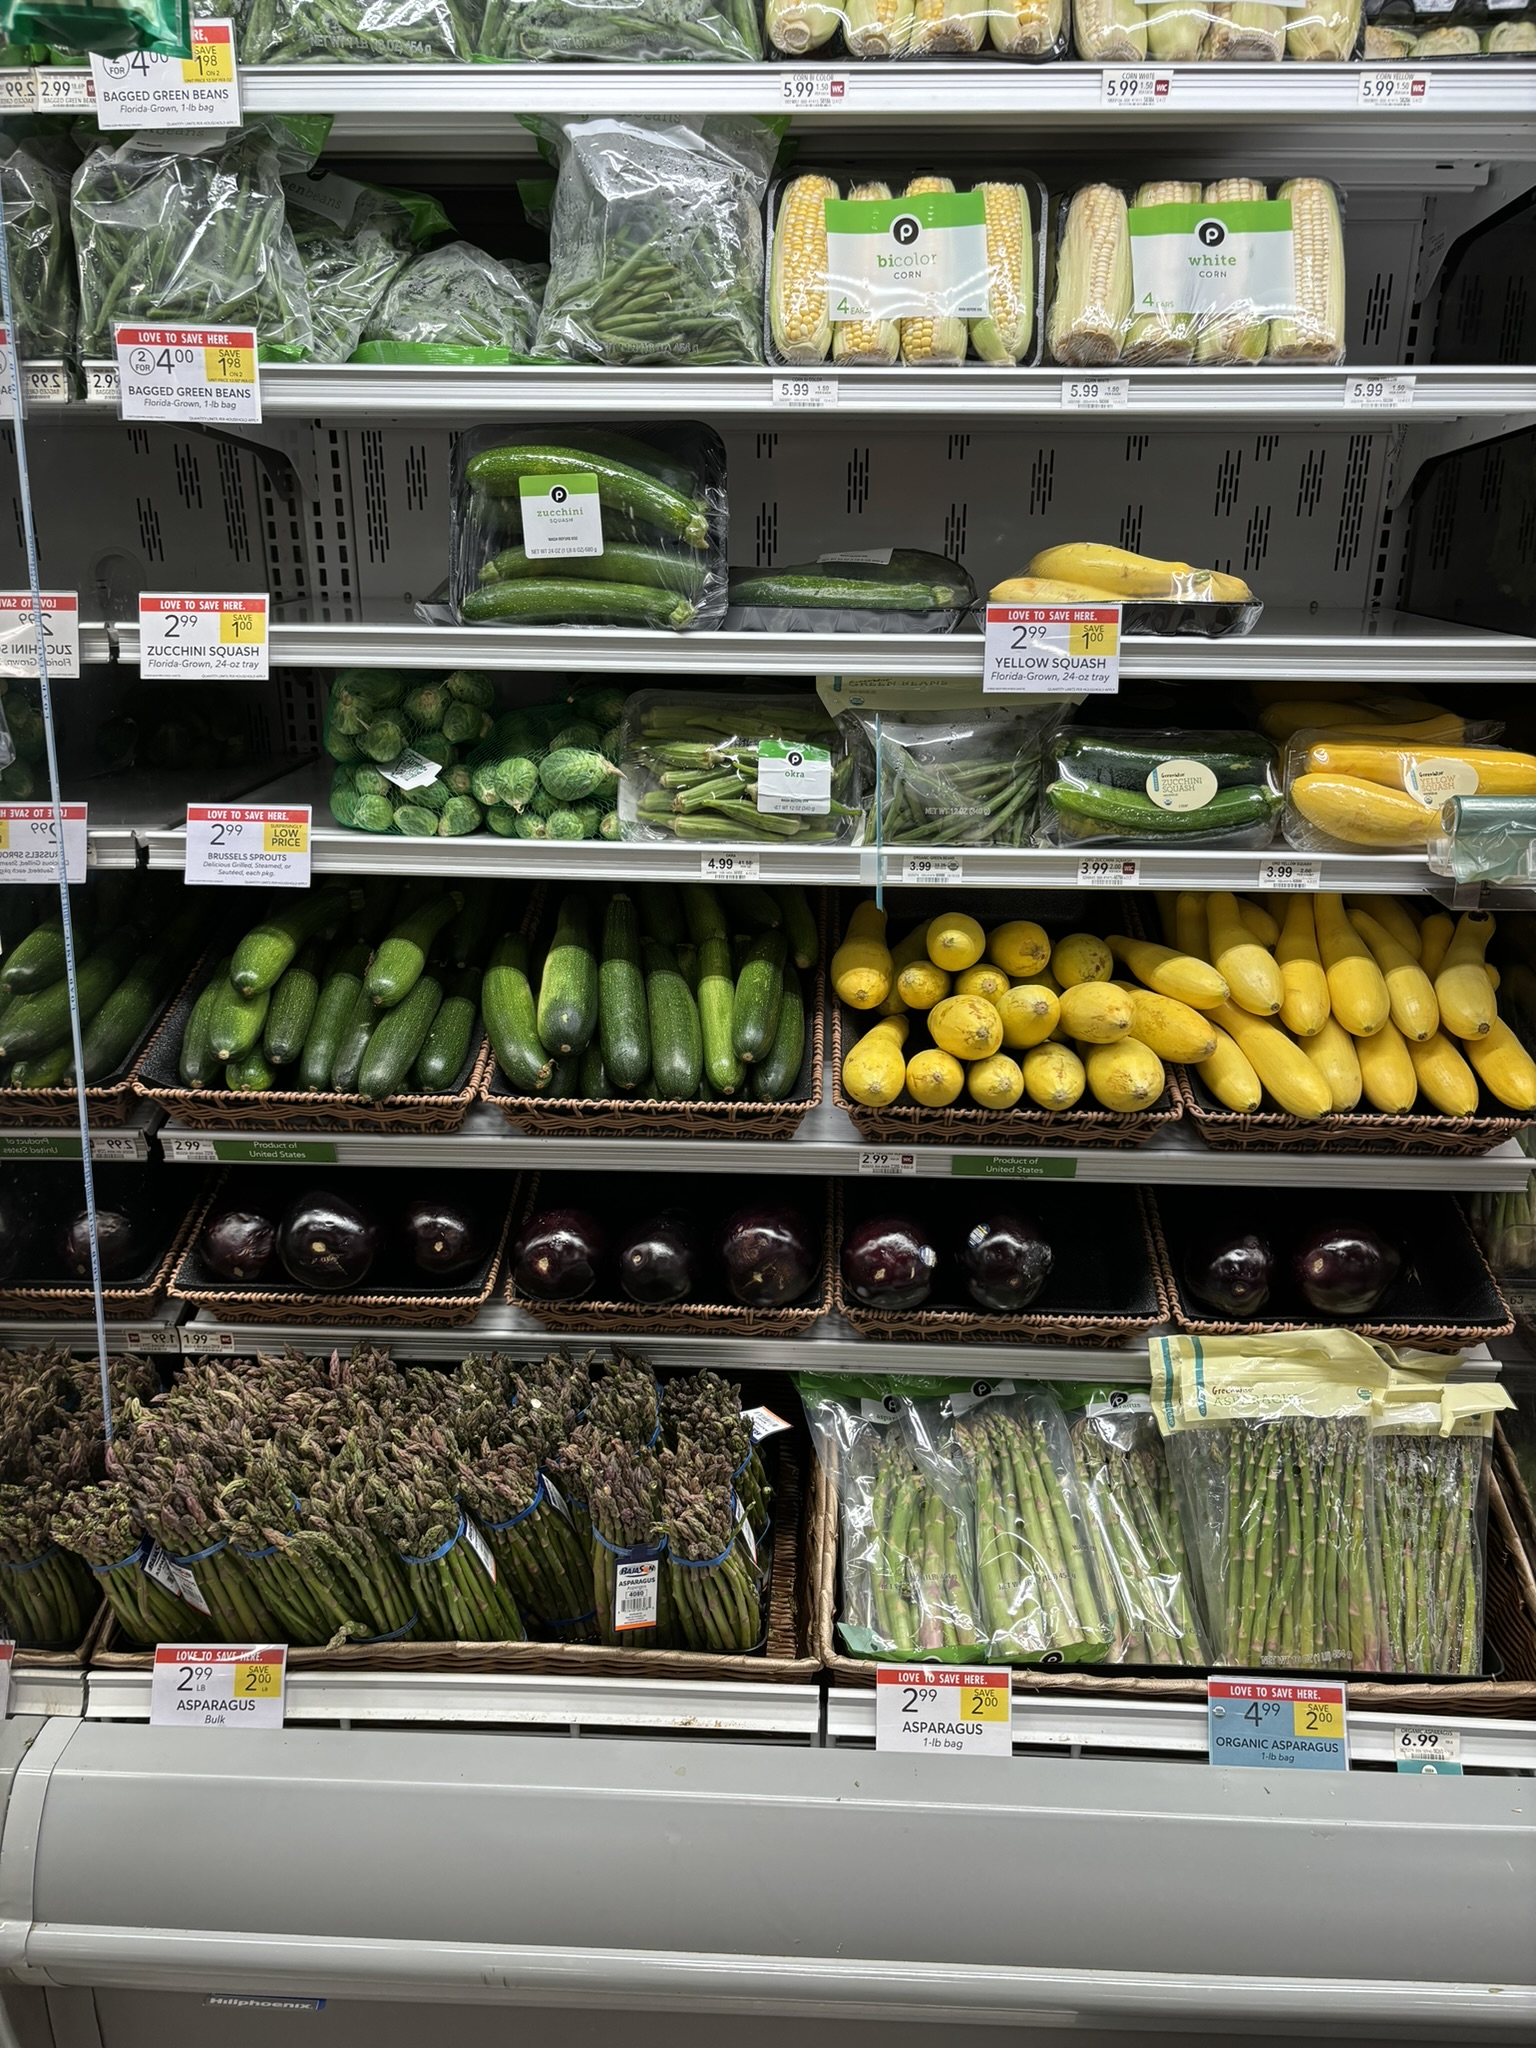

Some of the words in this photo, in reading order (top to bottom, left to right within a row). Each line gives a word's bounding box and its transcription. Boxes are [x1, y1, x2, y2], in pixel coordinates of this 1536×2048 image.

[195, 45, 217, 54] SAVE
[109, 67, 125, 75] FOR
[41, 81, 70, 97] 2.99
[783, 82, 814, 97] 5.99
[816, 83, 829, 91] 1.50
[1106, 80, 1138, 96] 5.99
[1140, 82, 1153, 90] 1.50
[1363, 81, 1394, 96] 5.99
[1396, 82, 1409, 90] 1.50
[103, 91, 150, 102] BAGGED
[153, 91, 190, 101] GREEN
[192, 89, 230, 100] BEANS
[120, 104, 179, 113] Florida-Grown,
[181, 104, 196, 112] 1-lb
[198, 103, 215, 114] bag
[877, 252, 937, 267] bicolor
[1188, 254, 1237, 266] white
[893, 270, 922, 280] CORN
[1199, 270, 1227, 278] CORN
[836, 296, 849, 314] 4
[1142, 292, 1154, 307] 4
[138, 332, 161, 343] LOVE
[165, 333, 177, 343] TO
[181, 334, 203, 344] SAVE
[207, 335, 232, 345] HERE.
[137, 350, 146, 362] 2
[218, 349, 240, 358] SAVE
[135, 363, 151, 372] FOR
[218, 357, 241, 376] 198
[128, 385, 175, 397] BAGGED
[177, 387, 213, 397] GREEN
[215, 388, 252, 399] BEANS
[782, 383, 809, 396] 5.99
[1070, 384, 1099, 397] 5.99
[1354, 383, 1383, 397] 5.99
[143, 398, 202, 409] Florida-Grown,
[204, 400, 219, 408] 1-lb
[221, 401, 237, 410] bag
[536, 507, 584, 517] zucchini
[160, 600, 181, 610] LOVE
[185, 601, 196, 610] TO
[200, 601, 219, 610] SAVE
[223, 601, 246, 611] HERE.
[232, 614, 253, 622] SAVE
[1008, 610, 1030, 621] LOVE
[1034, 611, 1045, 620] TO
[1049, 611, 1070, 621] SAVE
[1074, 611, 1097, 621] HERE.
[164, 614, 198, 638] 299
[231, 621, 253, 638] 100
[1083, 625, 1105, 633] SAVE
[1010, 625, 1047, 650] 299
[1082, 632, 1104, 650] 100
[147, 645, 206, 657] ZUCCHINI
[209, 646, 260, 658] SQUASH
[148, 659, 213, 669] Florida-Grown,
[215, 659, 240, 668] 24-oz
[242, 660, 260, 671] tray
[995, 657, 1049, 668] YELLOW
[1051, 658, 1106, 670] SQUASH
[990, 671, 1060, 682] Florida-Grown,
[1062, 672, 1090, 681] 24-oz
[1091, 673, 1110, 683] tray
[784, 769, 805, 778] okra
[1161, 777, 1202, 786] ZUCCHINI
[1420, 775, 1456, 785] YELLOW
[1162, 784, 1195, 793] SQUASH
[1421, 782, 1456, 792] SQUASH
[207, 810, 227, 819] LOVE
[231, 811, 241, 819] TO
[245, 811, 264, 820] SAVE
[267, 812, 289, 821] HERE.
[210, 823, 243, 846] 299
[273, 829, 299, 838] LOW
[271, 838, 301, 847] PRICE
[208, 852, 248, 861] BRUSSELS
[249, 853, 287, 862] SPROUTS
[255, 862, 283, 870] Steamed,
[708, 858, 733, 869] 4.99
[910, 861, 931, 871] 3.99
[1081, 862, 1108, 874] 3.99
[1267, 866, 1293, 878] 3.99
[175, 1141, 200, 1150] 2.99
[279, 1151, 306, 1159] States
[862, 1154, 888, 1164] 2.99
[985, 1166, 1015, 1174] United
[1017, 1166, 1044, 1174] States
[184, 1334, 208, 1344] 1.99
[619, 1577, 656, 1587] ASPARAGUS
[176, 1650, 198, 1661] LOVE
[201, 1651, 212, 1661] TO
[216, 1651, 237, 1661] SAVE
[249, 1665, 269, 1674] SAVE
[177, 1666, 213, 1691] 299
[245, 1673, 272, 1691] 200
[898, 1672, 920, 1682] LOVE
[924, 1673, 935, 1683] TO
[939, 1674, 960, 1684] SAVE
[964, 1675, 988, 1685] HERE.
[974, 1689, 996, 1697] SAVE
[1230, 1686, 1252, 1696] LOVE
[1256, 1687, 1268, 1697] TO
[1272, 1688, 1293, 1699] SAVE
[1297, 1690, 1321, 1700] HERE.
[176, 1699, 256, 1711] ASPARAGUS
[901, 1687, 937, 1713] 299
[971, 1696, 998, 1715] 200
[1244, 1701, 1281, 1727] 499
[1307, 1703, 1329, 1713] SAVE
[204, 1714, 226, 1724] Bulk
[1306, 1711, 1333, 1730] 200
[902, 1721, 983, 1735] ASPARAGUS
[923, 1737, 942, 1748] 1-lb
[943, 1738, 963, 1750] bag
[1216, 1737, 1269, 1750] ORGANIC
[1271, 1739, 1339, 1753] ASPARAGUS
[1401, 1733, 1438, 1747] 6.99
[1261, 1752, 1277, 1761] 1-lb
[1278, 1753, 1295, 1764] bag
